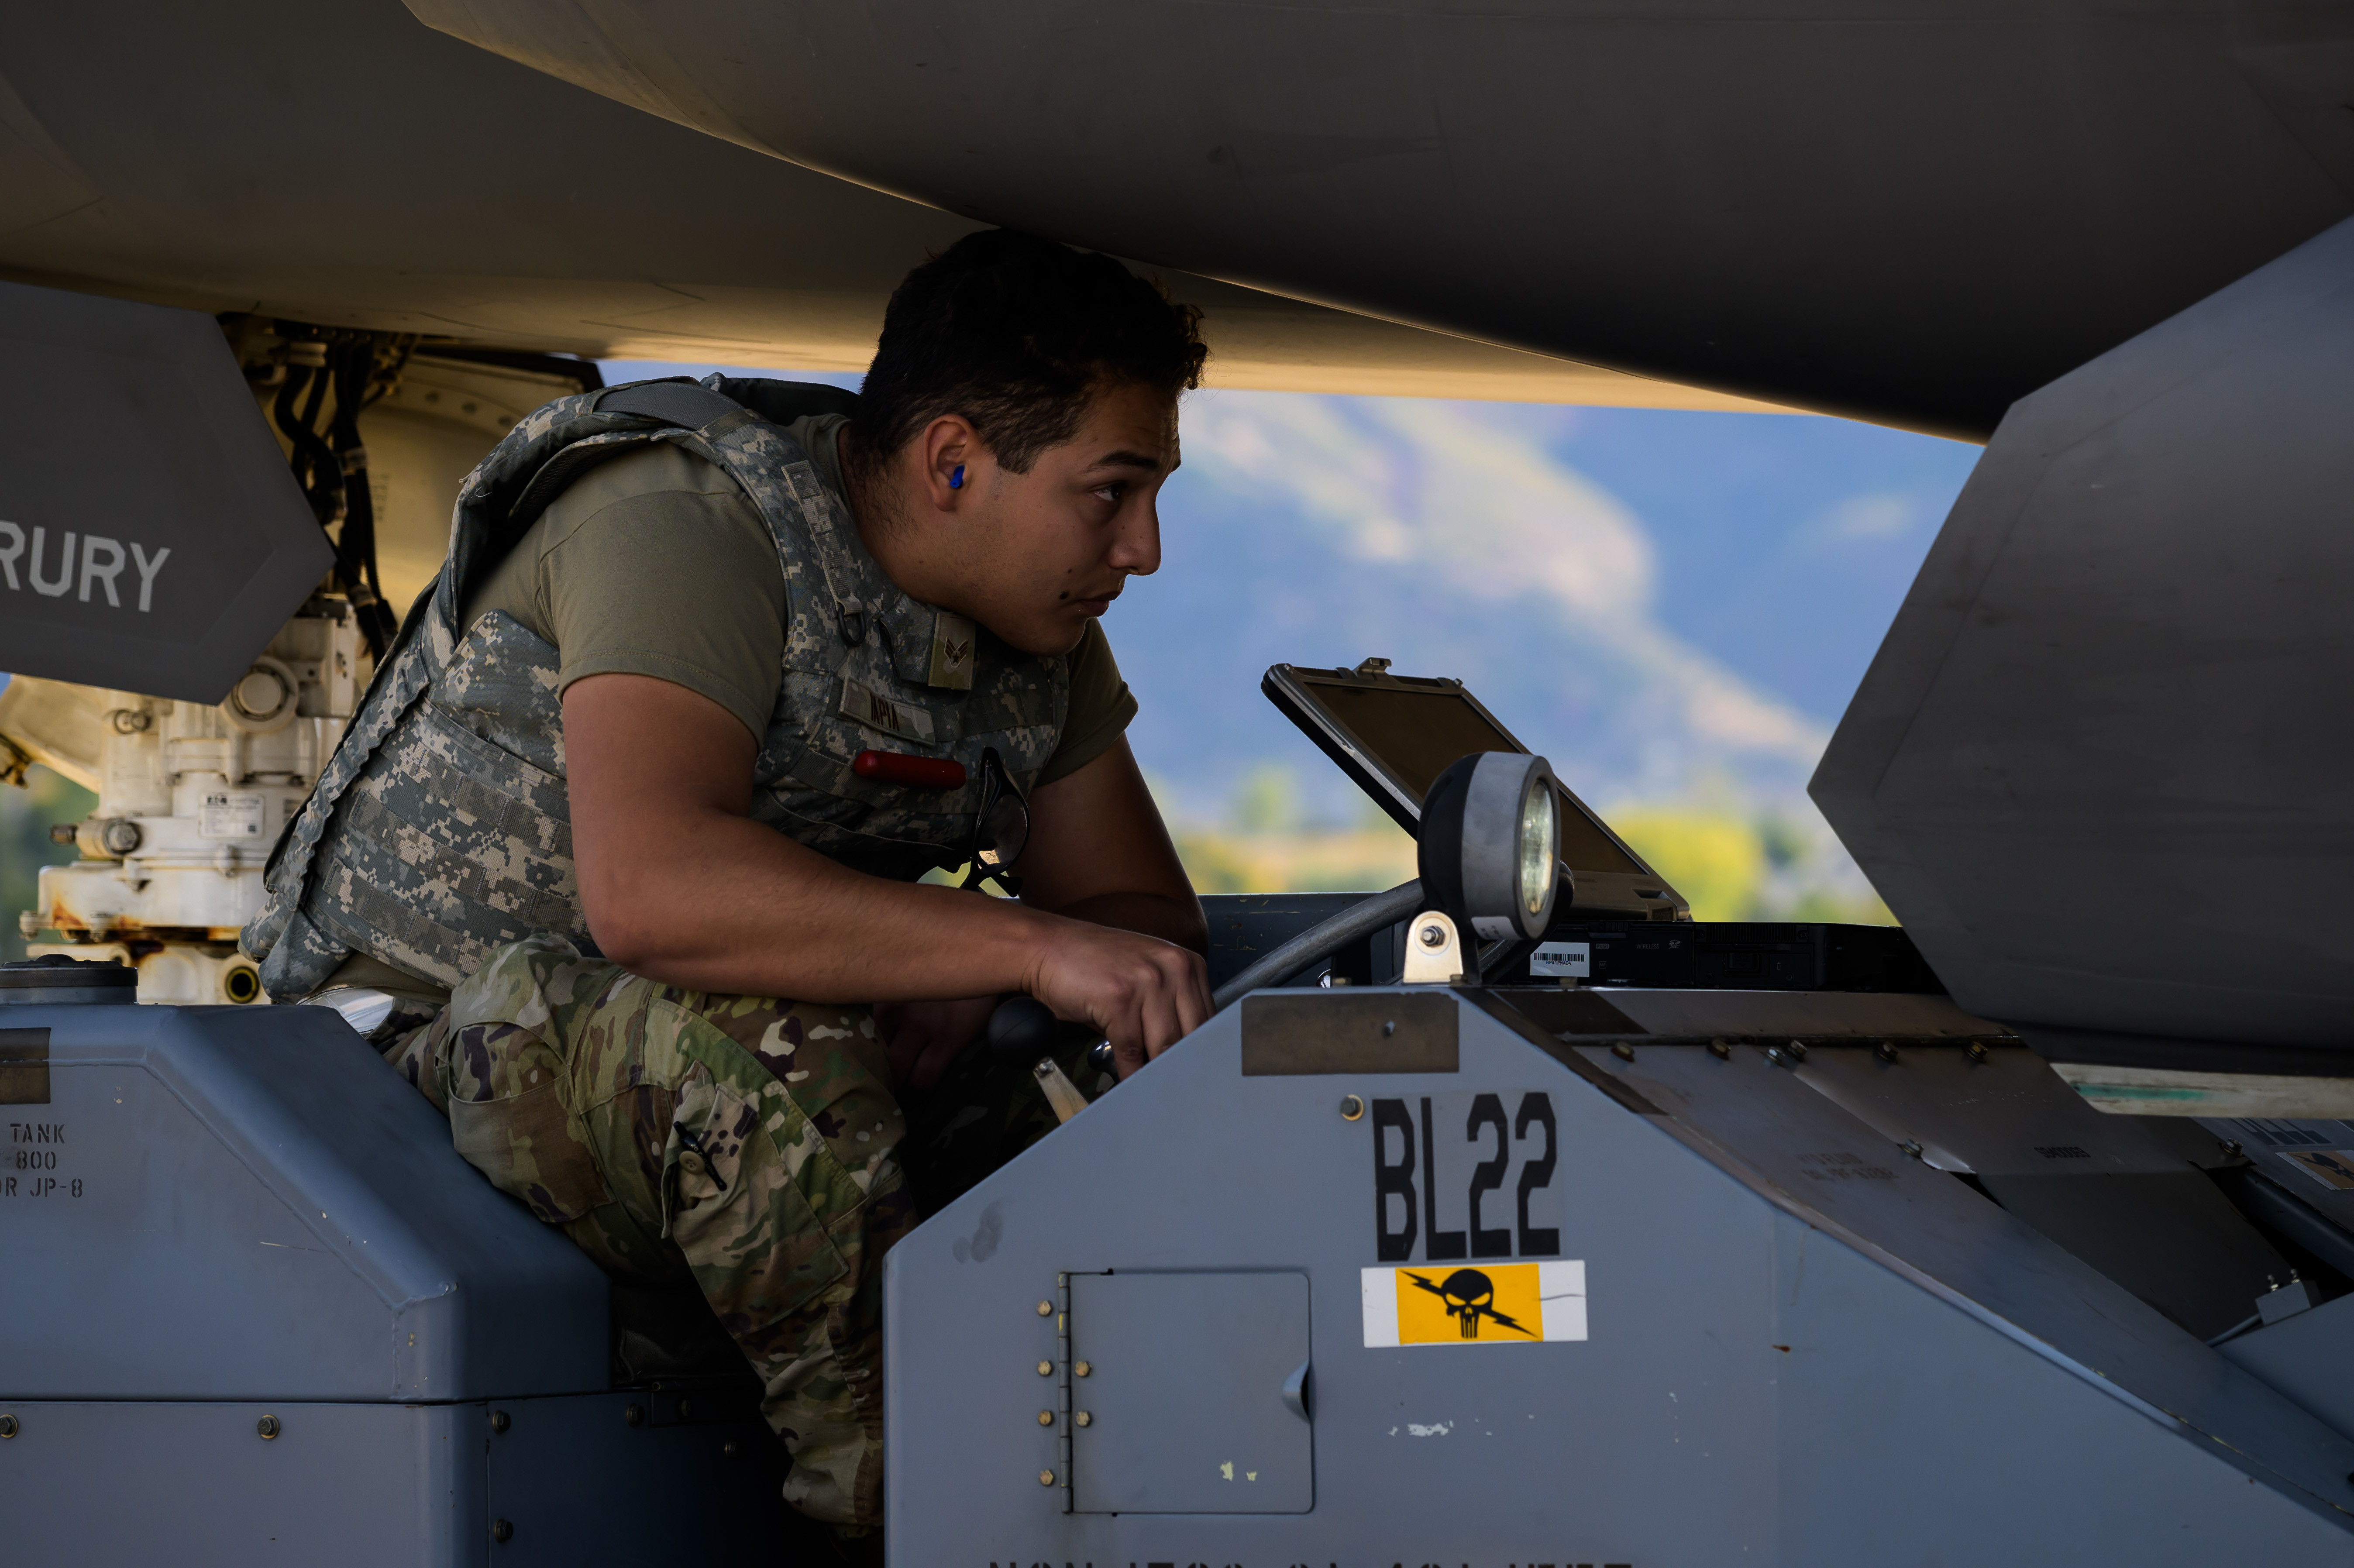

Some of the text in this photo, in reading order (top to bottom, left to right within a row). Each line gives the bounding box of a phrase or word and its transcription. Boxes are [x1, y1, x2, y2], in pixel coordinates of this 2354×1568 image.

[10, 1123, 65, 1144] TANK
[16, 1150, 56, 1170] 800
[0, 1177, 83, 1198] R JP-8
[1372, 1093, 1560, 1262] BL22
